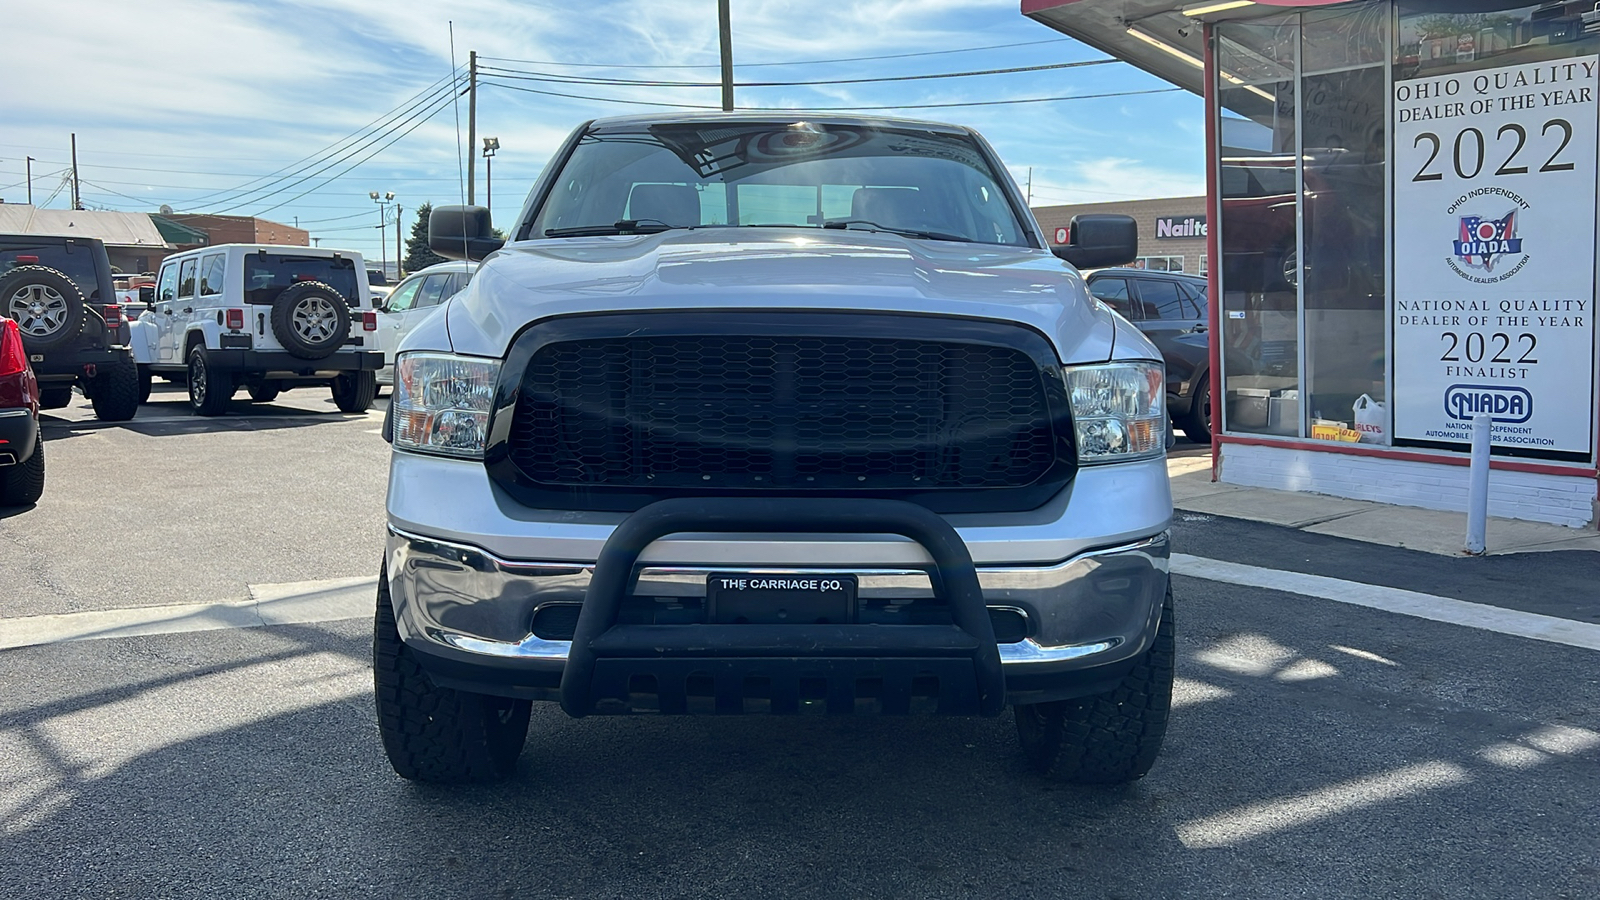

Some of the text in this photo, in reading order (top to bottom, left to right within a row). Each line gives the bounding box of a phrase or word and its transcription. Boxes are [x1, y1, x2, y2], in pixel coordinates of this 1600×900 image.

[1396, 79, 1460, 102] OHIO
[1473, 60, 1597, 95] QUALITY
[1399, 87, 1593, 123] DEALER OF THE YEAR
[1411, 118, 1576, 183] 2022
[1447, 187, 1531, 215] OHIO INDEPENDENT
[1461, 240, 1510, 255] OIADA
[1445, 254, 1531, 285] AUTOMOBILE DEALERS ASSOCIATION
[1397, 299, 1588, 314] NATIONAL QUALITY
[1400, 315, 1585, 328] DEALER OF THE YEAR
[1440, 331, 1539, 364] 2022
[1445, 365, 1530, 380] FINALIST
[1451, 392, 1524, 416] NIADA
[1425, 430, 1469, 440] AUTOMOBILE
[1503, 436, 1555, 446] ASSOCIATION
[1445, 422, 1533, 435] NATION DEPENDENT
[720, 579, 843, 591] THE CARRIAGE CO.
